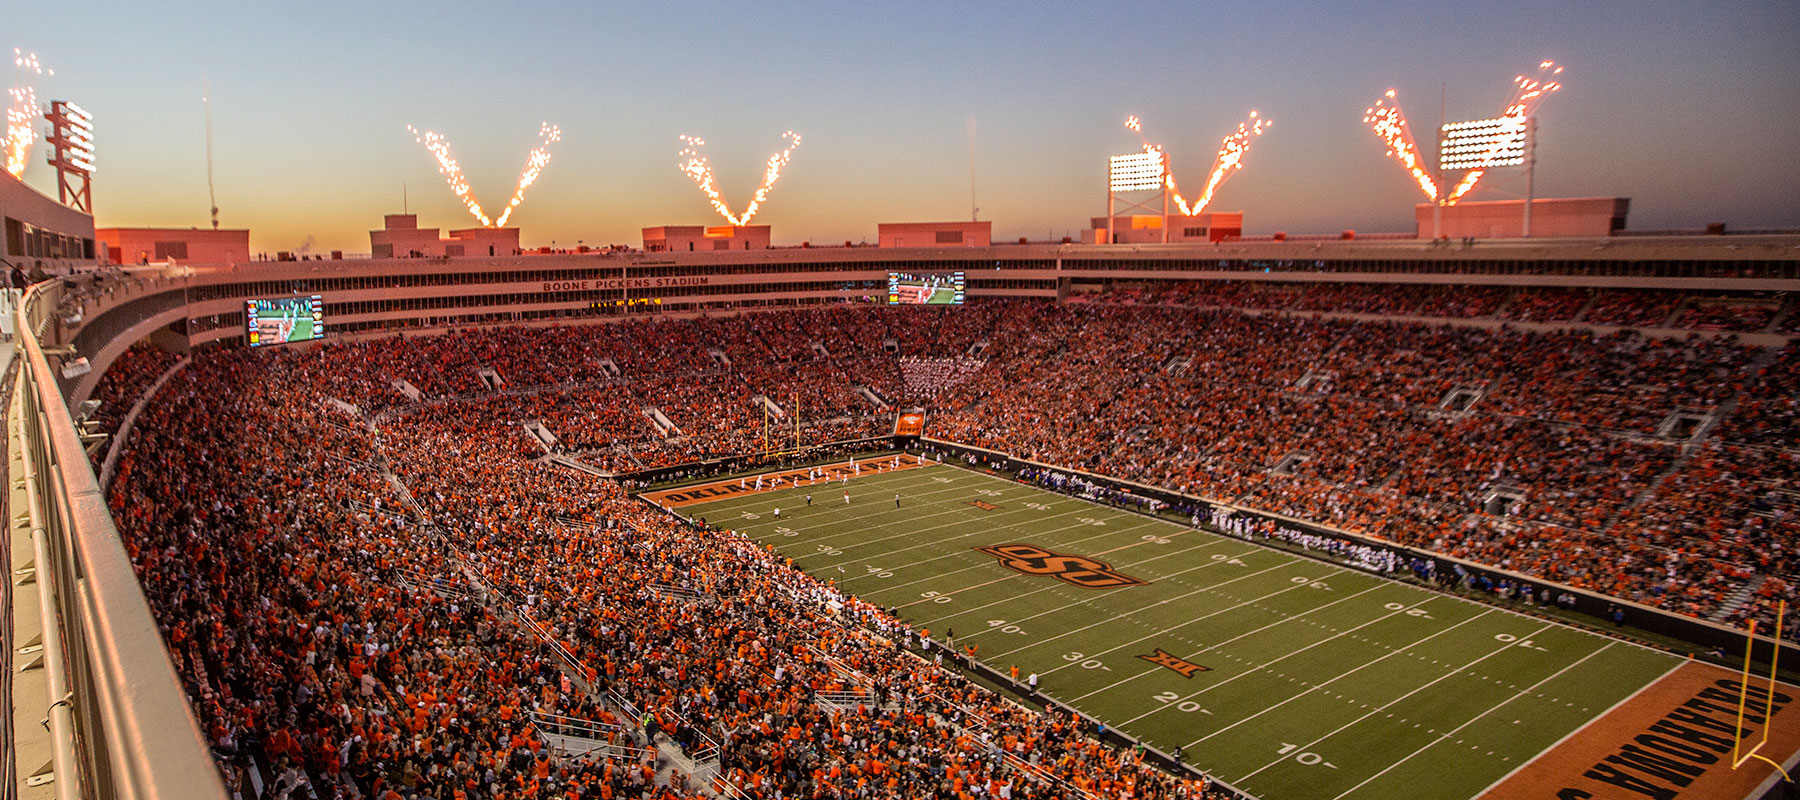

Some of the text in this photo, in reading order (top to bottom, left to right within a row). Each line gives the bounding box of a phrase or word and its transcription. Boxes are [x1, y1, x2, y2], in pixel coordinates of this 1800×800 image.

[543, 277, 708, 292] BOONE PICKENS STADIUM
[774, 527, 799, 537] 20
[1142, 535, 1171, 544] 50
[817, 545, 843, 556] 30
[972, 543, 1152, 590] OSU
[1210, 554, 1242, 565] 40
[867, 566, 894, 578] 40
[1290, 576, 1327, 589] 30
[920, 590, 952, 604] 50
[1384, 602, 1428, 617] 20
[987, 619, 1021, 634] 40
[1494, 633, 1535, 648] 10
[1062, 651, 1103, 669] 30
[1152, 691, 1201, 713] 20
[1582, 679, 1794, 800] OKLAHOMA
[1276, 742, 1322, 765] 10
